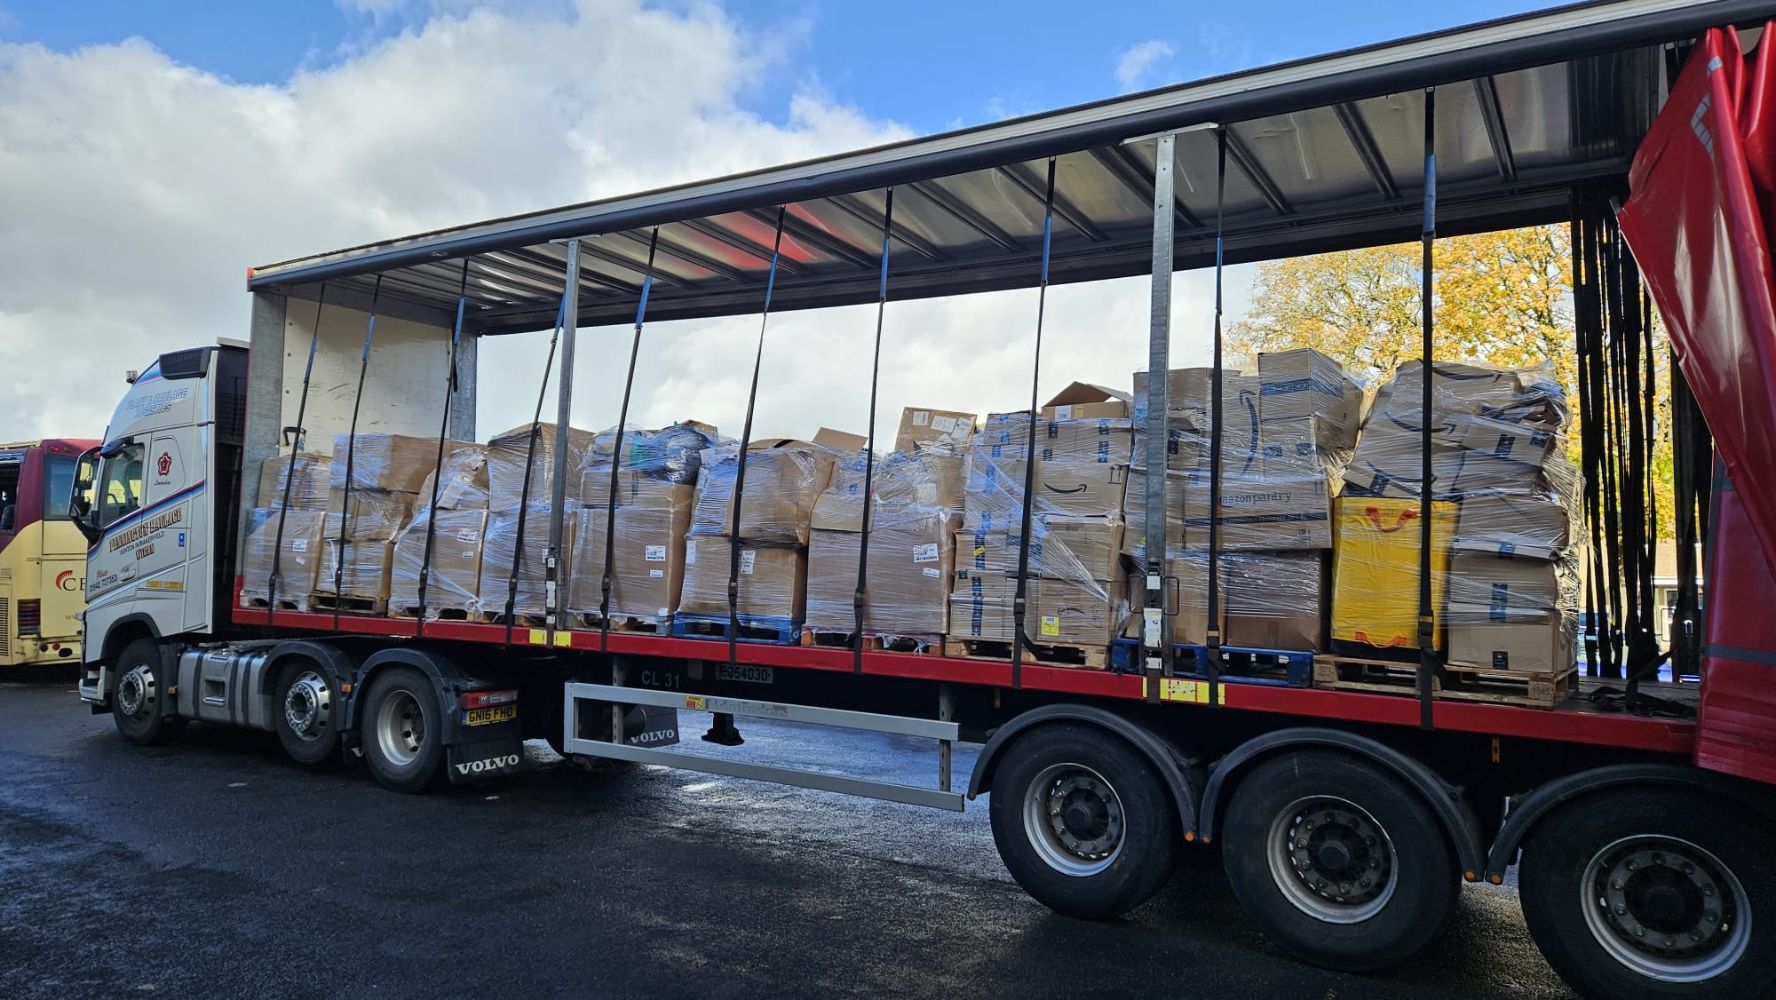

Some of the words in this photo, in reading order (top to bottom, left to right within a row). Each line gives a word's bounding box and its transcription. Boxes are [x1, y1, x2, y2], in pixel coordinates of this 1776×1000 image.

[1253, 492, 1292, 504] pantry
[641, 670, 660, 685] CL
[664, 673, 680, 688] 31
[468, 709, 491, 723] GN16
[630, 729, 675, 744] VOLVO
[455, 754, 520, 775] VOLVO
